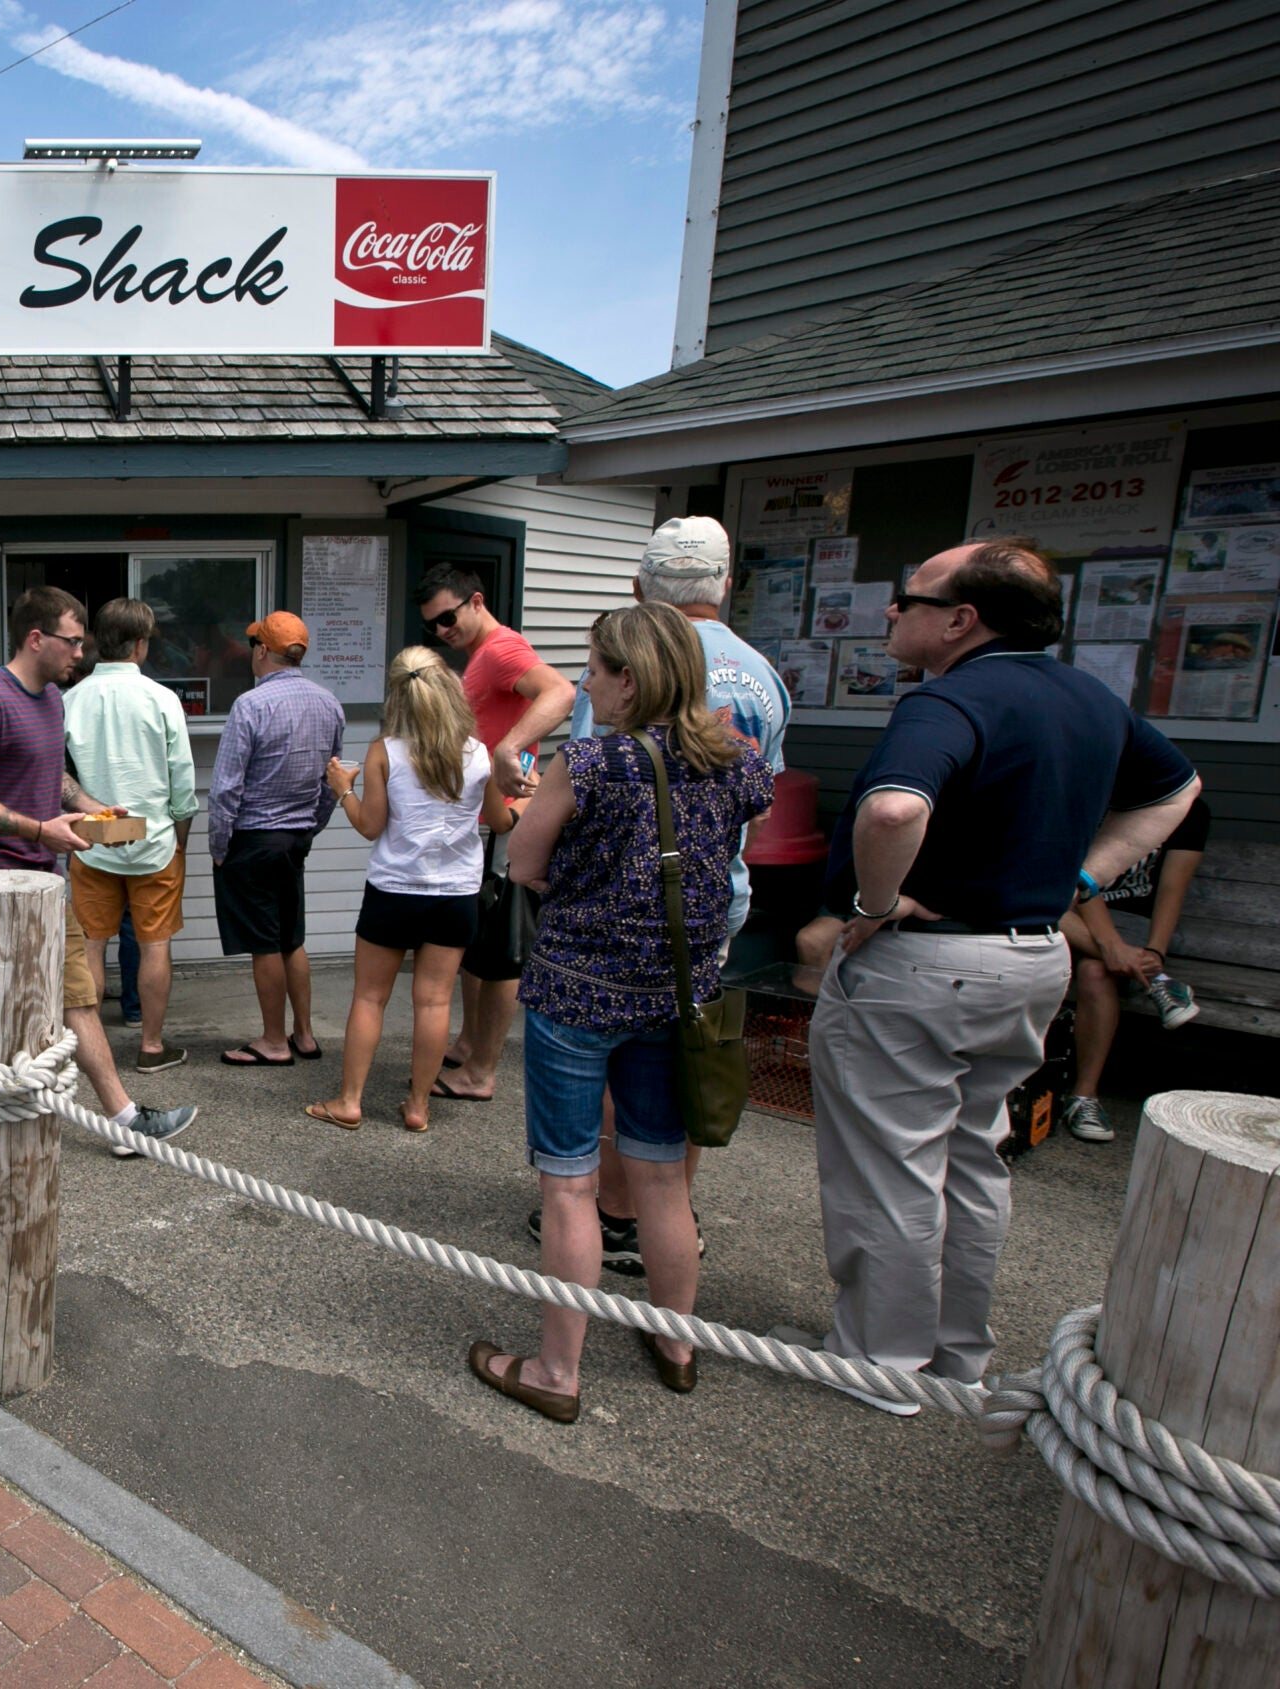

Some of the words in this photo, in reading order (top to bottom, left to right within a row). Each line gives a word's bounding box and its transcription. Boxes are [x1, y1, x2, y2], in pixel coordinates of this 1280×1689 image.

[342, 221, 483, 272] Coca-Cola
[20, 216, 288, 309] Shack
[392, 274, 427, 286] classic
[1036, 443, 1127, 462] AMERICA'S
[1130, 437, 1174, 453] BEST
[1035, 455, 1118, 475] LOBSTER
[1123, 449, 1173, 467] ROLL
[995, 486, 1062, 509] 2012
[1071, 478, 1145, 502] 2013
[999, 511, 1026, 523] THE
[1029, 507, 1076, 521] CLAM
[1081, 503, 1140, 517] SHACK
[819, 551, 851, 560] BEST
[185, 691, 205, 700] WE'RE
[182, 702, 205, 715] EN
